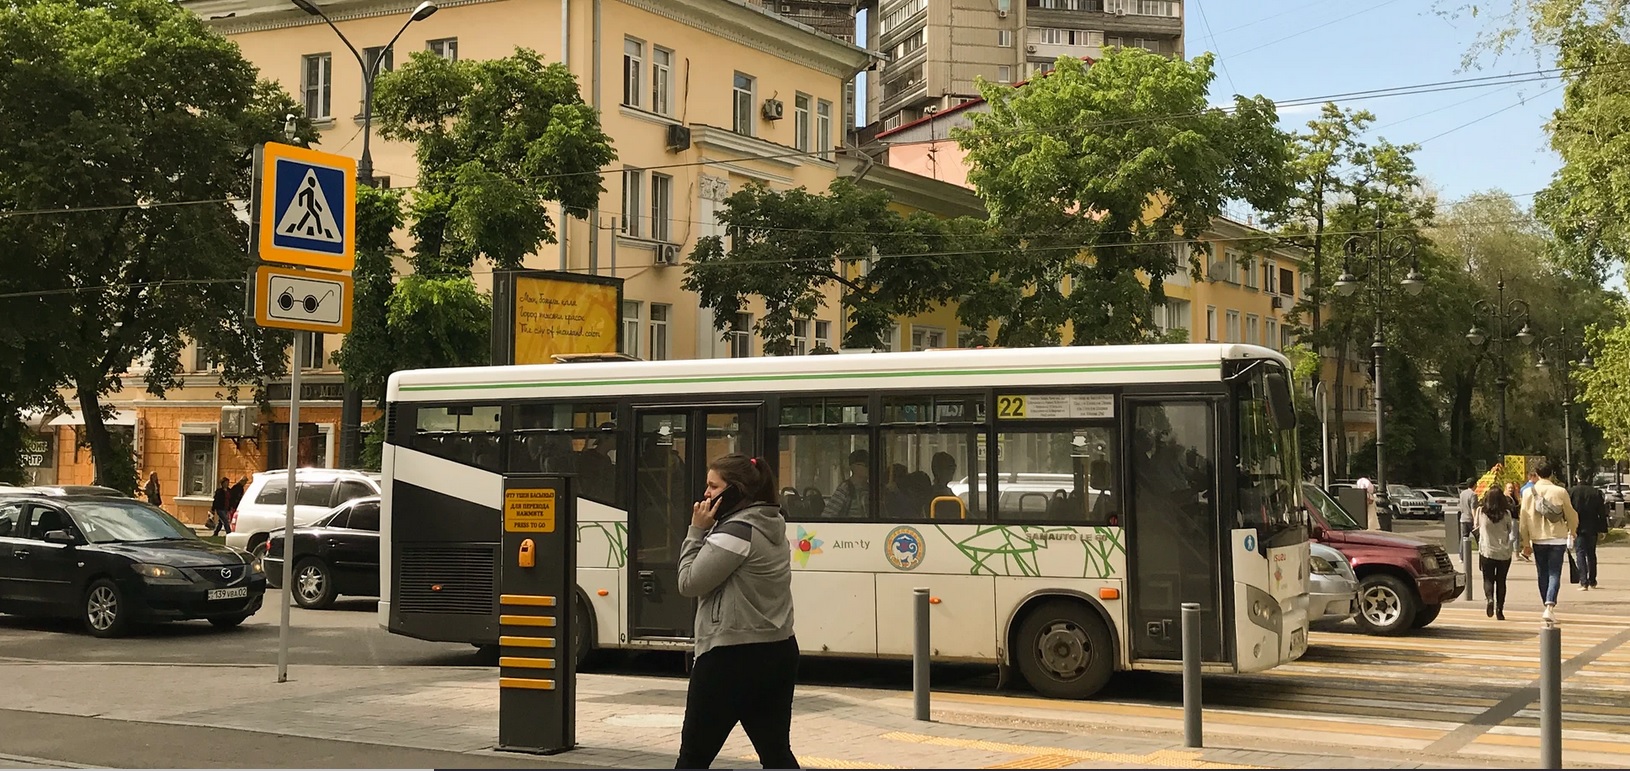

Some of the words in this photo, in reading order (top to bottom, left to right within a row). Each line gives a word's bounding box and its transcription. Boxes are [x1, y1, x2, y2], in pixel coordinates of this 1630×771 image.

[519, 322, 532, 333] The
[534, 327, 545, 338] city
[546, 327, 554, 338] of
[1000, 397, 1024, 417] 22
